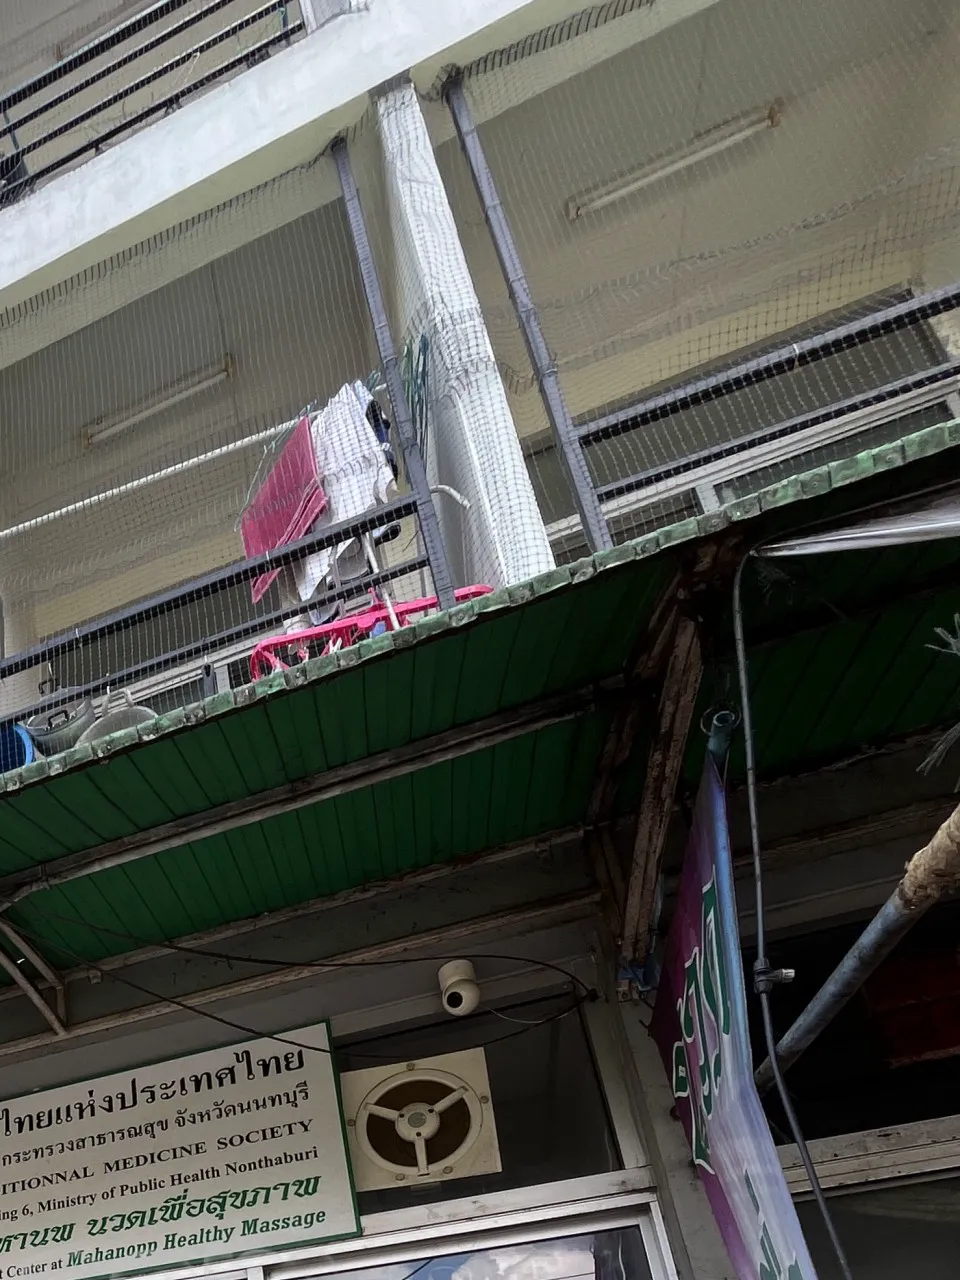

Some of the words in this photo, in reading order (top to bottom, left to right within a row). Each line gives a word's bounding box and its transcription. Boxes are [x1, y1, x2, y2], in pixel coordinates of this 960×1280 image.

[2, 1118, 169, 1167] กระทรวงสาธารณสุข
[174, 1080, 309, 1129] จังหวัดนนทบุรี
[103, 1141, 207, 1175] MEDICINE
[217, 1118, 314, 1150] SOCIETY
[22, 1204, 34, 1218] 6,
[38, 1192, 97, 1214] Ministry
[102, 1186, 116, 1201] of
[120, 1177, 166, 1202] Public
[170, 1165, 221, 1188] Health
[225, 1145, 319, 1177] Nonthaburi
[87, 1175, 322, 1237] นวดเพื่อสุขภาพ
[6, 1261, 48, 1279] Center
[50, 1259, 63, 1271] at
[66, 1239, 157, 1268] Mahanopp
[162, 1225, 236, 1252] Healthy
[240, 1210, 326, 1237] Massage
